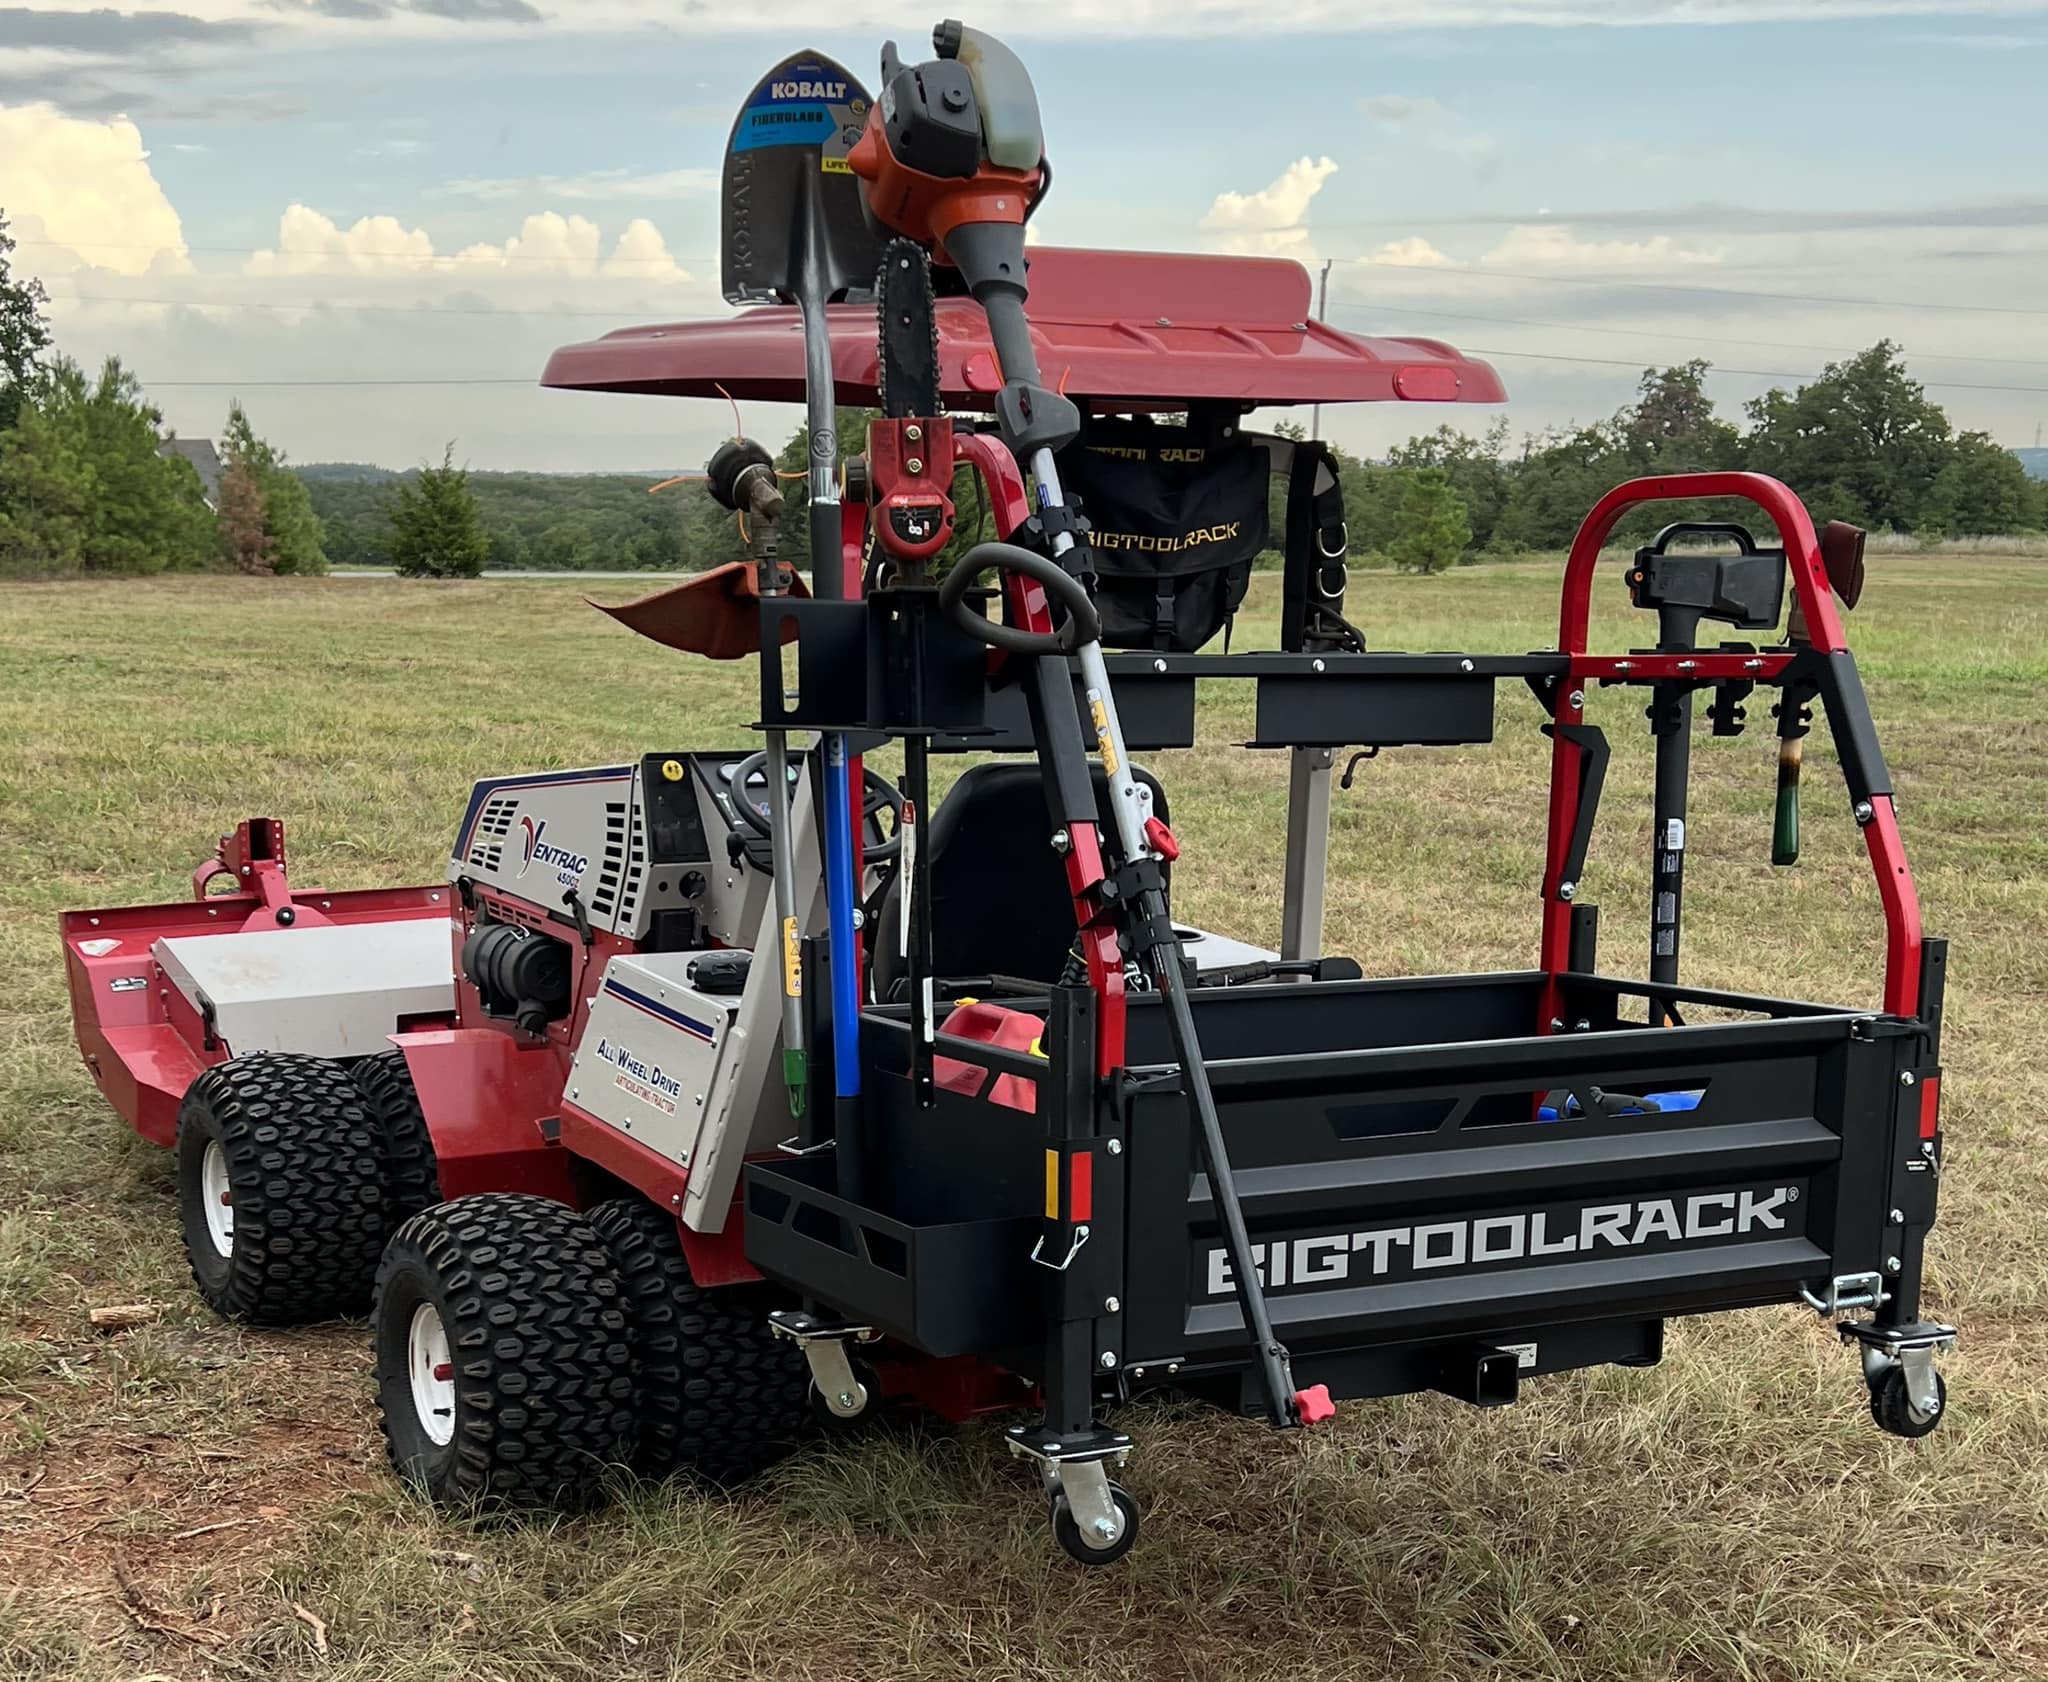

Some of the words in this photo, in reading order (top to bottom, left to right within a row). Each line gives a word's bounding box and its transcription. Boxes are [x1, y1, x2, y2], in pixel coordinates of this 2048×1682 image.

[771, 81, 847, 99] KOBALT
[519, 815, 588, 877] VENTRAC
[597, 1038, 614, 1062] ALL
[617, 1047, 648, 1081] WHEEL
[651, 1066, 681, 1097] DRIVE
